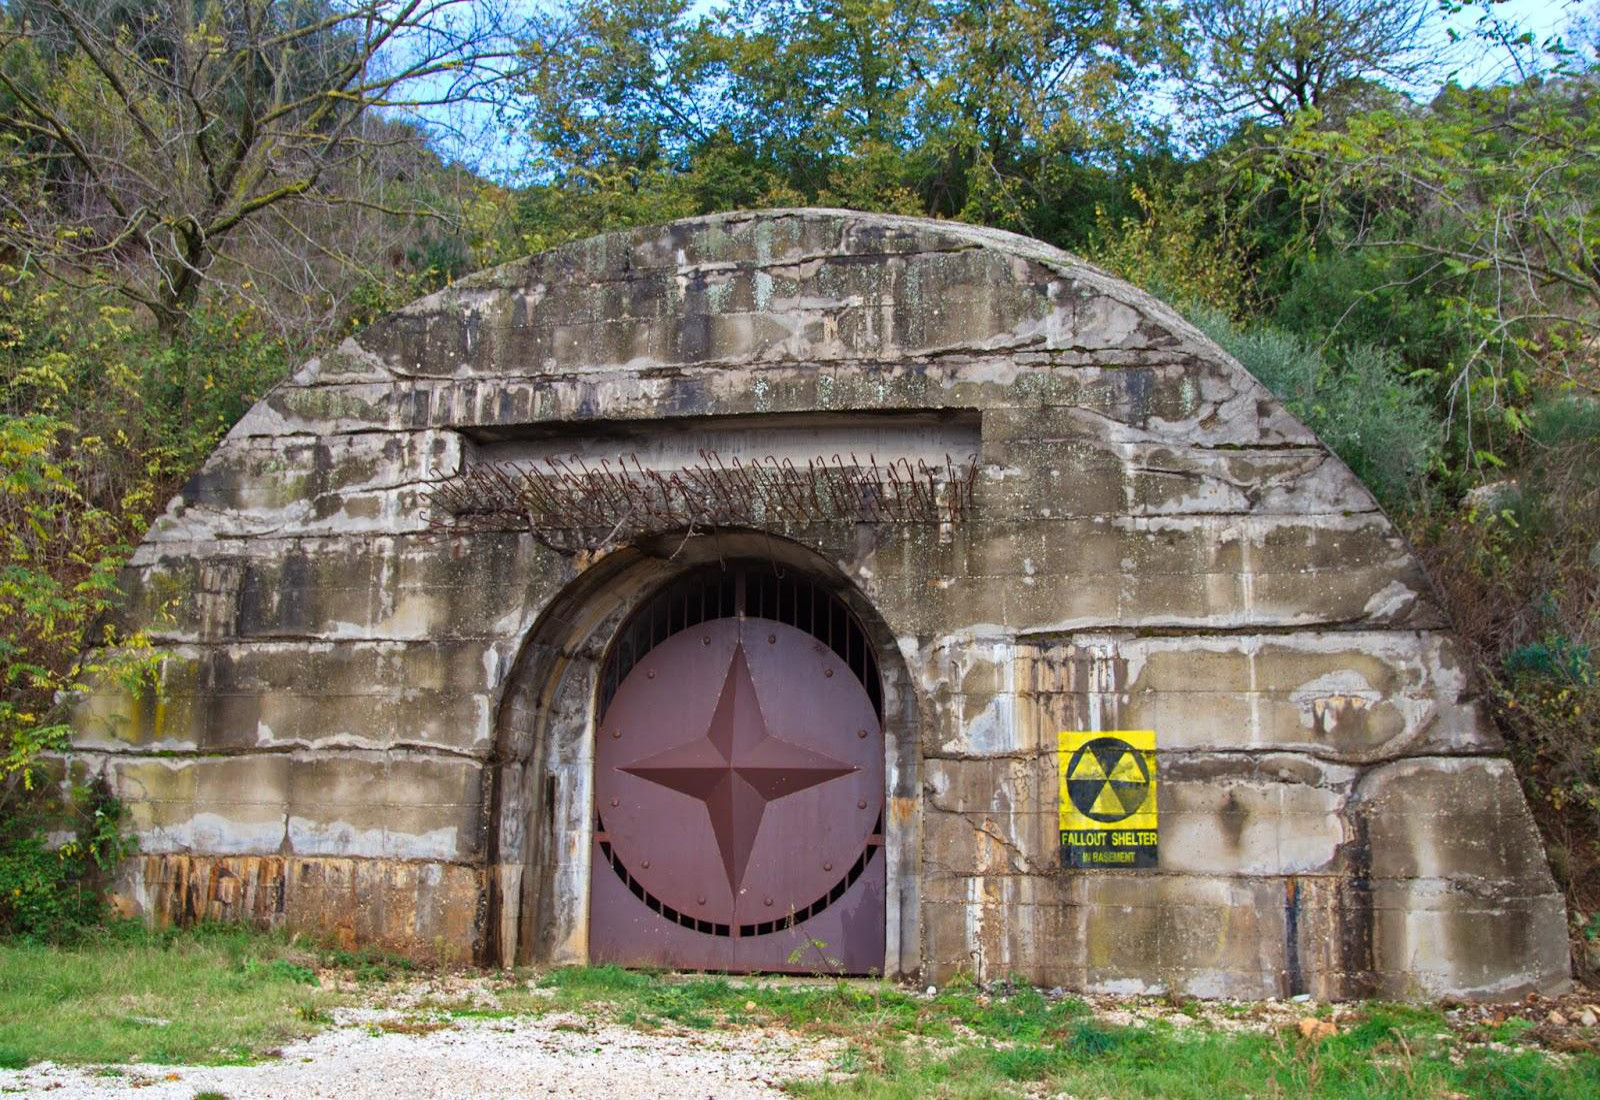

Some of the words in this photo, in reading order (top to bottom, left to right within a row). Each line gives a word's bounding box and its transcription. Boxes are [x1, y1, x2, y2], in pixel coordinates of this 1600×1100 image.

[1061, 832, 1107, 846] FALLOUT
[1111, 832, 1157, 846] SHELTER
[1082, 852, 1090, 863] IN
[1092, 852, 1136, 863] BASEMENT
